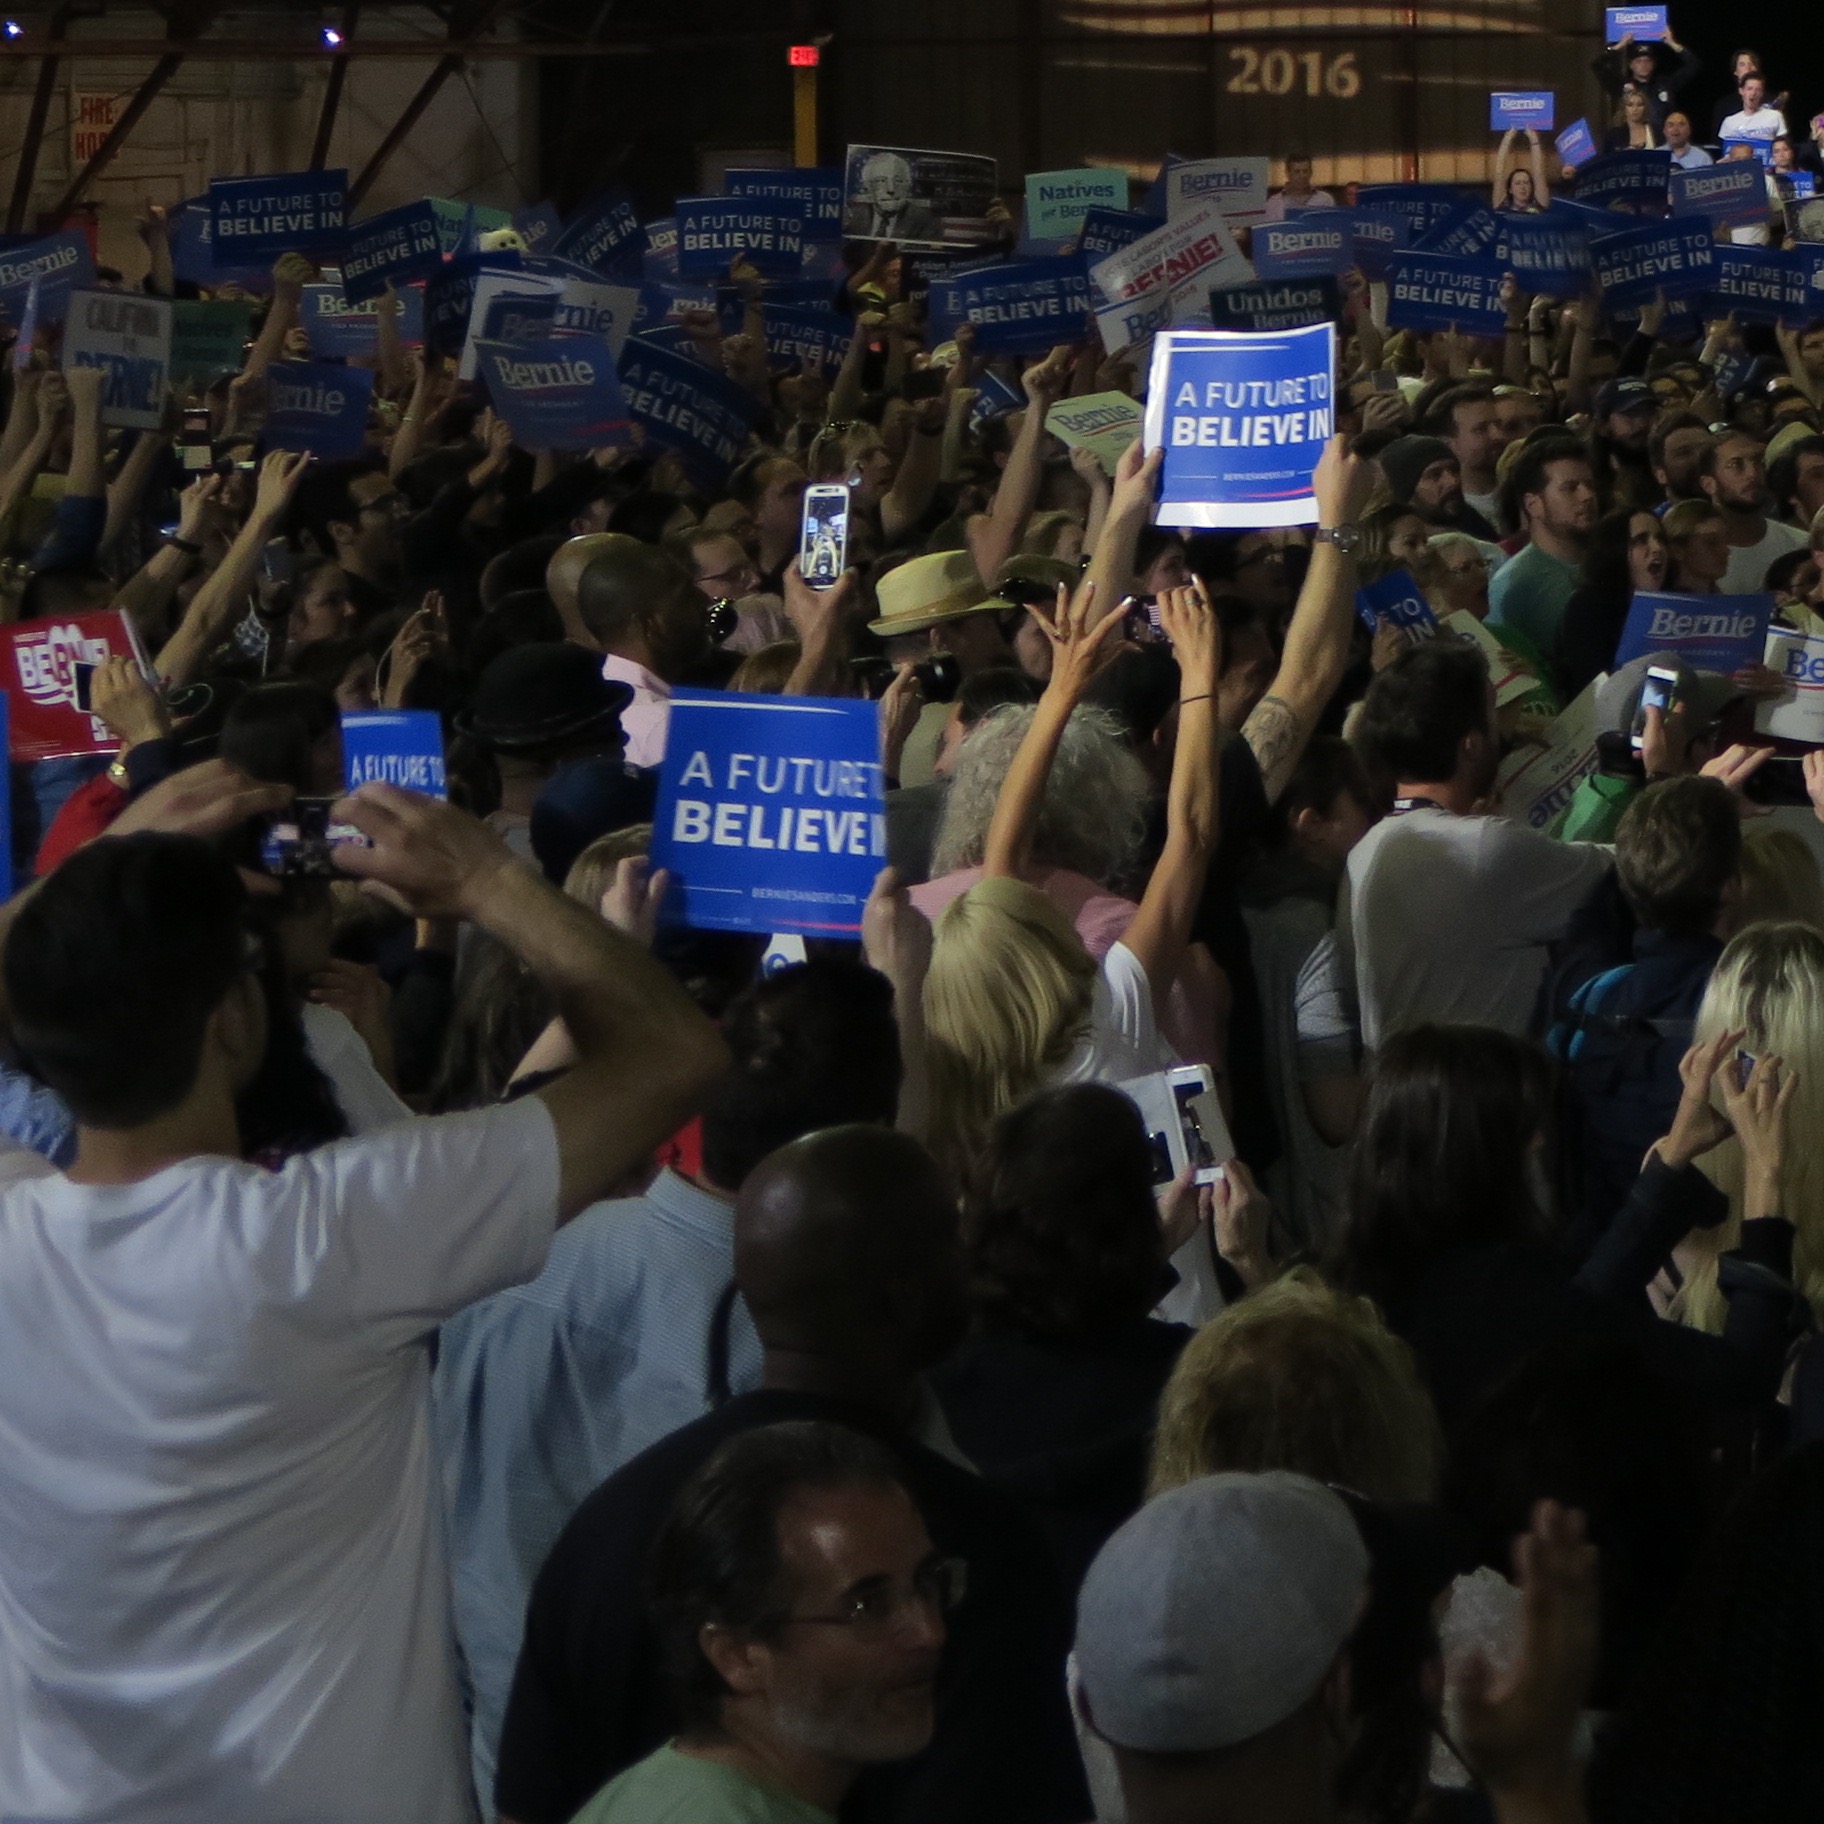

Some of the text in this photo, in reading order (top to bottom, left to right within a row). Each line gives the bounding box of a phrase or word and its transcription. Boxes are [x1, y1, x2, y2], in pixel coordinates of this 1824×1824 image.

[1225, 46, 1362, 98] 2016
[1039, 184, 1114, 200] Natives
[1180, 170, 1253, 192] Bernie
[1684, 171, 1753, 199] Bernie
[218, 210, 343, 237] BELIEVE IN
[701, 217, 773, 231] FUTURE
[778, 218, 801, 233] TO
[819, 204, 840, 218] IN
[683, 234, 800, 252] BELIEVE IN
[1268, 229, 1342, 254] Bernie
[1611, 238, 1677, 265] FUTURE
[1683, 235, 1708, 251] TO
[1600, 248, 1712, 288] BELIEVE IN
[1721, 262, 1806, 286] FUTURE TO
[968, 295, 1089, 325] BELIEVE IN
[1227, 287, 1323, 312] Unidos
[493, 356, 595, 389] Bernie
[1174, 373, 1328, 409] A FUTURE TO
[1052, 404, 1138, 432] Bernie
[1171, 408, 1330, 447] BELIEVE IN
[1391, 596, 1417, 619] TO
[1407, 617, 1436, 645] IN
[1647, 606, 1757, 641] Bernie
[678, 750, 870, 799] A FUTURE
[672, 797, 869, 856] BELIEVE
